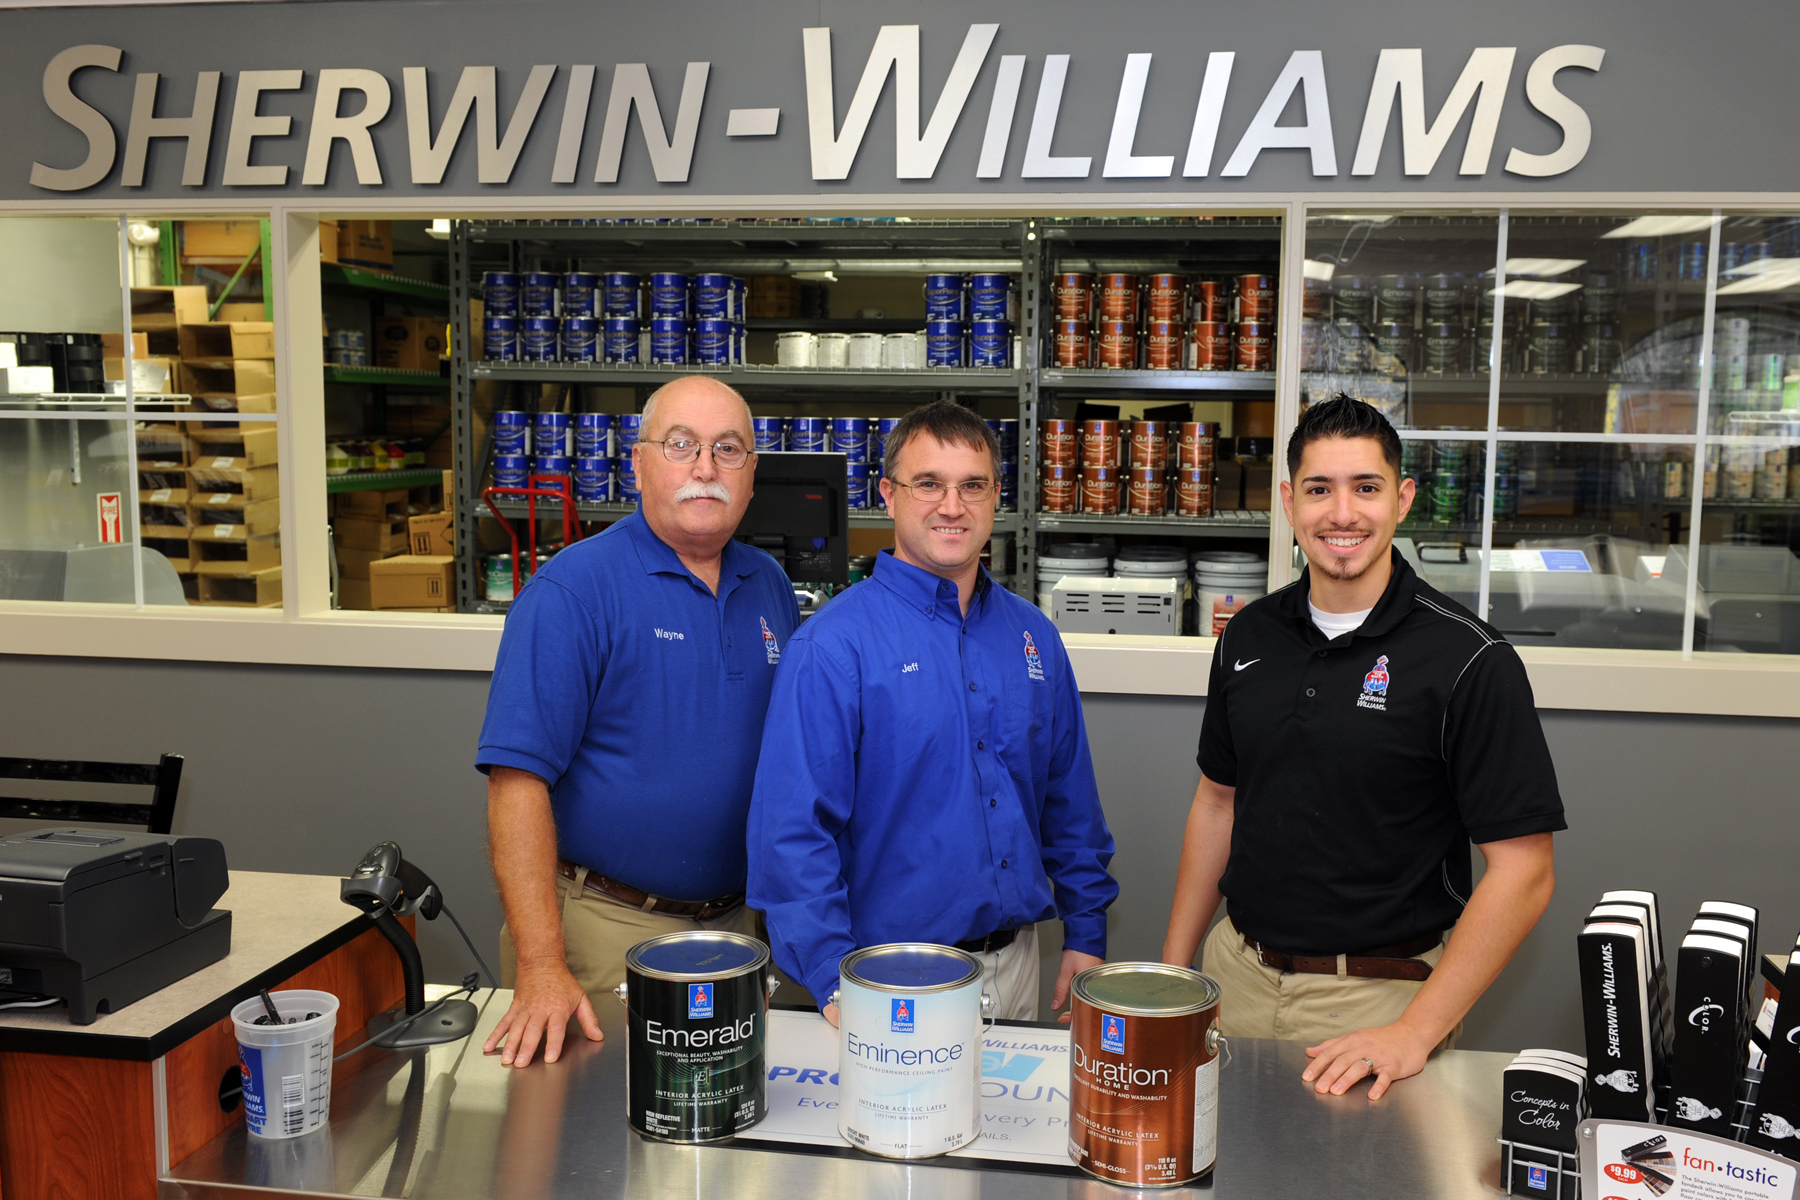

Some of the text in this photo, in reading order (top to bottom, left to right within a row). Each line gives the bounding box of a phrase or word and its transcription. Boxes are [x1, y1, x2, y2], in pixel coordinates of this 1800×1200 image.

[654, 628, 684, 640] Wayne
[902, 662, 919, 673] Jeff
[1358, 693, 1386, 704] SHERWIN
[647, 1014, 753, 1048] Emerald
[656, 1050, 688, 1058] EXCEPTIONAL
[712, 1046, 743, 1056] WASHABILITY
[848, 1032, 962, 1066] Eminence
[856, 1062, 868, 1070] HIGH
[869, 1066, 910, 1076] PERFORMANCE
[1074, 1043, 1168, 1086] Duration
[656, 1084, 744, 1098] INTERIOR ACRYLIC LATEX
[1090, 1084, 1117, 1096] DURABILITY
[1096, 1077, 1130, 1091] HOME
[698, 1098, 728, 1106] WARRANTY
[858, 1098, 890, 1110] INTERIOR
[926, 1104, 948, 1112] LATEX
[1510, 1090, 1570, 1110] Concepts in
[874, 1112, 897, 1120] LIFETIME
[1518, 1108, 1561, 1130] Color
[1076, 1112, 1100, 1130] INTERIOR
[1102, 1126, 1133, 1138] ACRYLIC
[1088, 1129, 1138, 1146] LIFETIME WARRANTY
[1094, 1160, 1126, 1174] SEMI-GLOSS
[1610, 1165, 1637, 1180] $9.99
[1681, 1181, 1704, 1190] fandeck
[1704, 1186, 1724, 1196] allows
[1682, 1174, 1769, 1200] The Sherwin-Williams portable
[1696, 1190, 1714, 1199] colors
